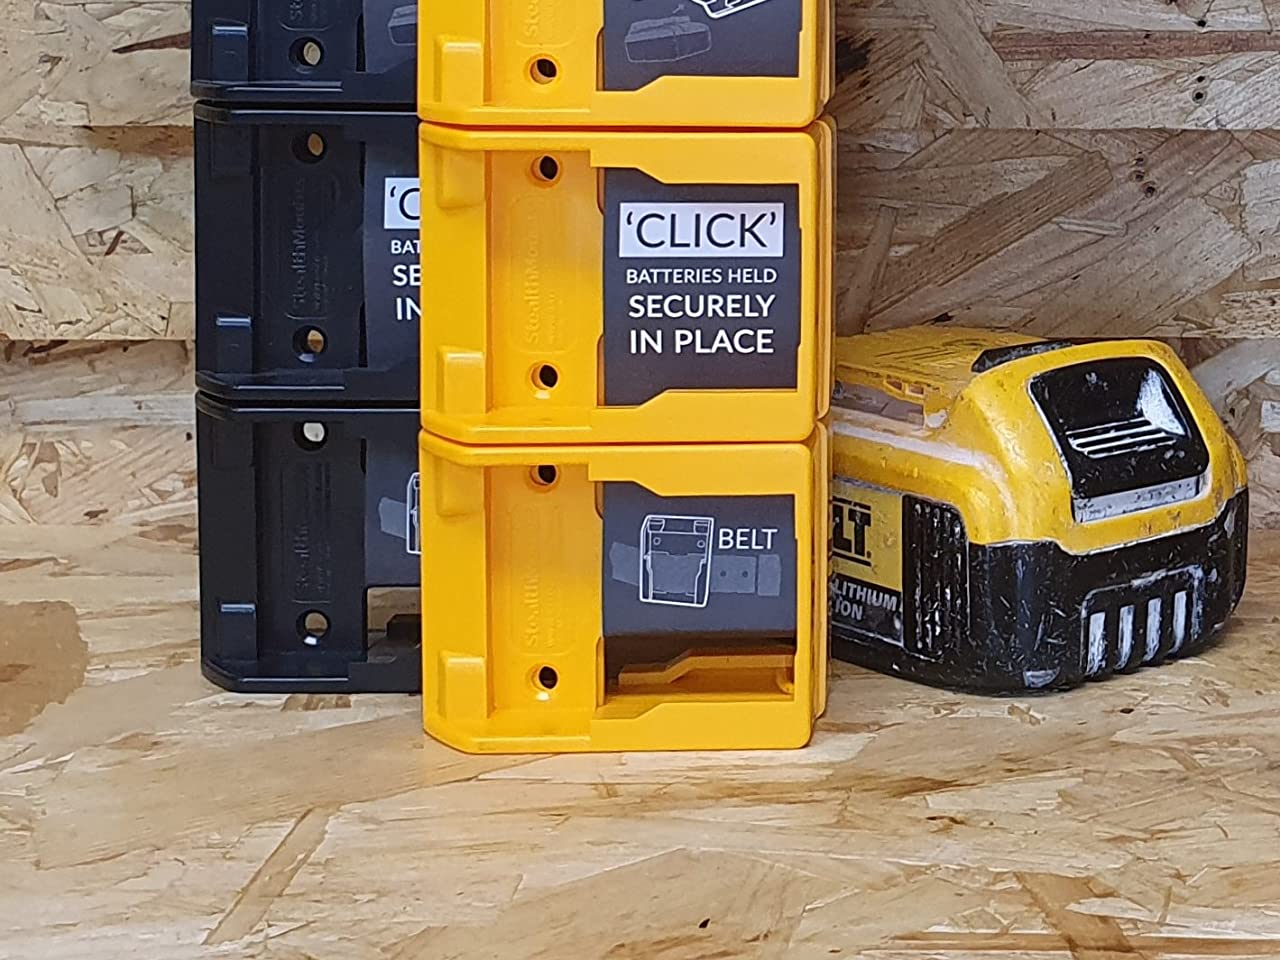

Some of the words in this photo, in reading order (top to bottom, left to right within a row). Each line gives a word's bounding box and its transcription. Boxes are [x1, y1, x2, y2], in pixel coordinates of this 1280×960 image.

[626, 268, 723, 284] BATTERIES
[727, 268, 778, 284] HELD
[628, 294, 776, 318] SECURELY
[630, 329, 664, 354] IN
[674, 328, 775, 354] PLACE
[718, 527, 779, 550] BELT
